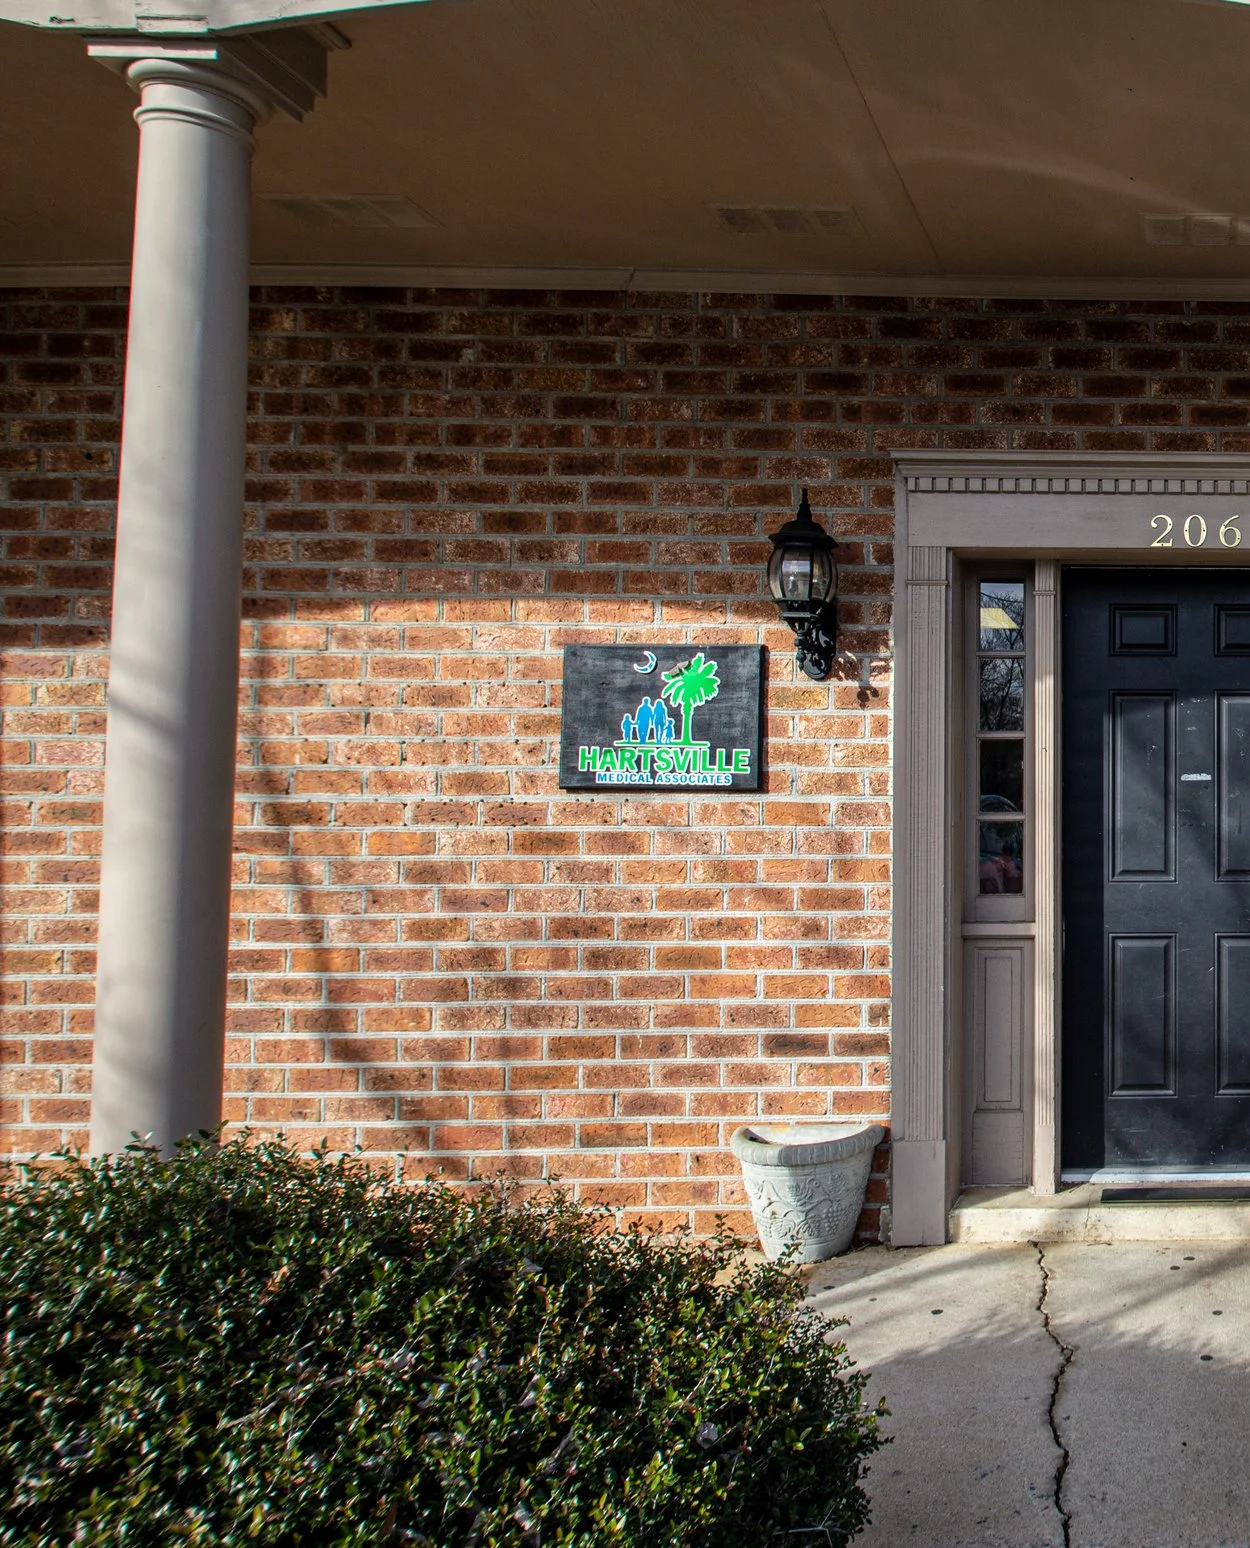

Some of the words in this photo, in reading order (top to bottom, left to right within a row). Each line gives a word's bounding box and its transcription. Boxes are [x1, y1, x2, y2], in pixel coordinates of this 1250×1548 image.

[1150, 514, 1241, 548] 206
[578, 746, 751, 773] HARTSVILLE
[596, 772, 653, 784] MEDICAL
[656, 773, 732, 786] ASSOCIATES
